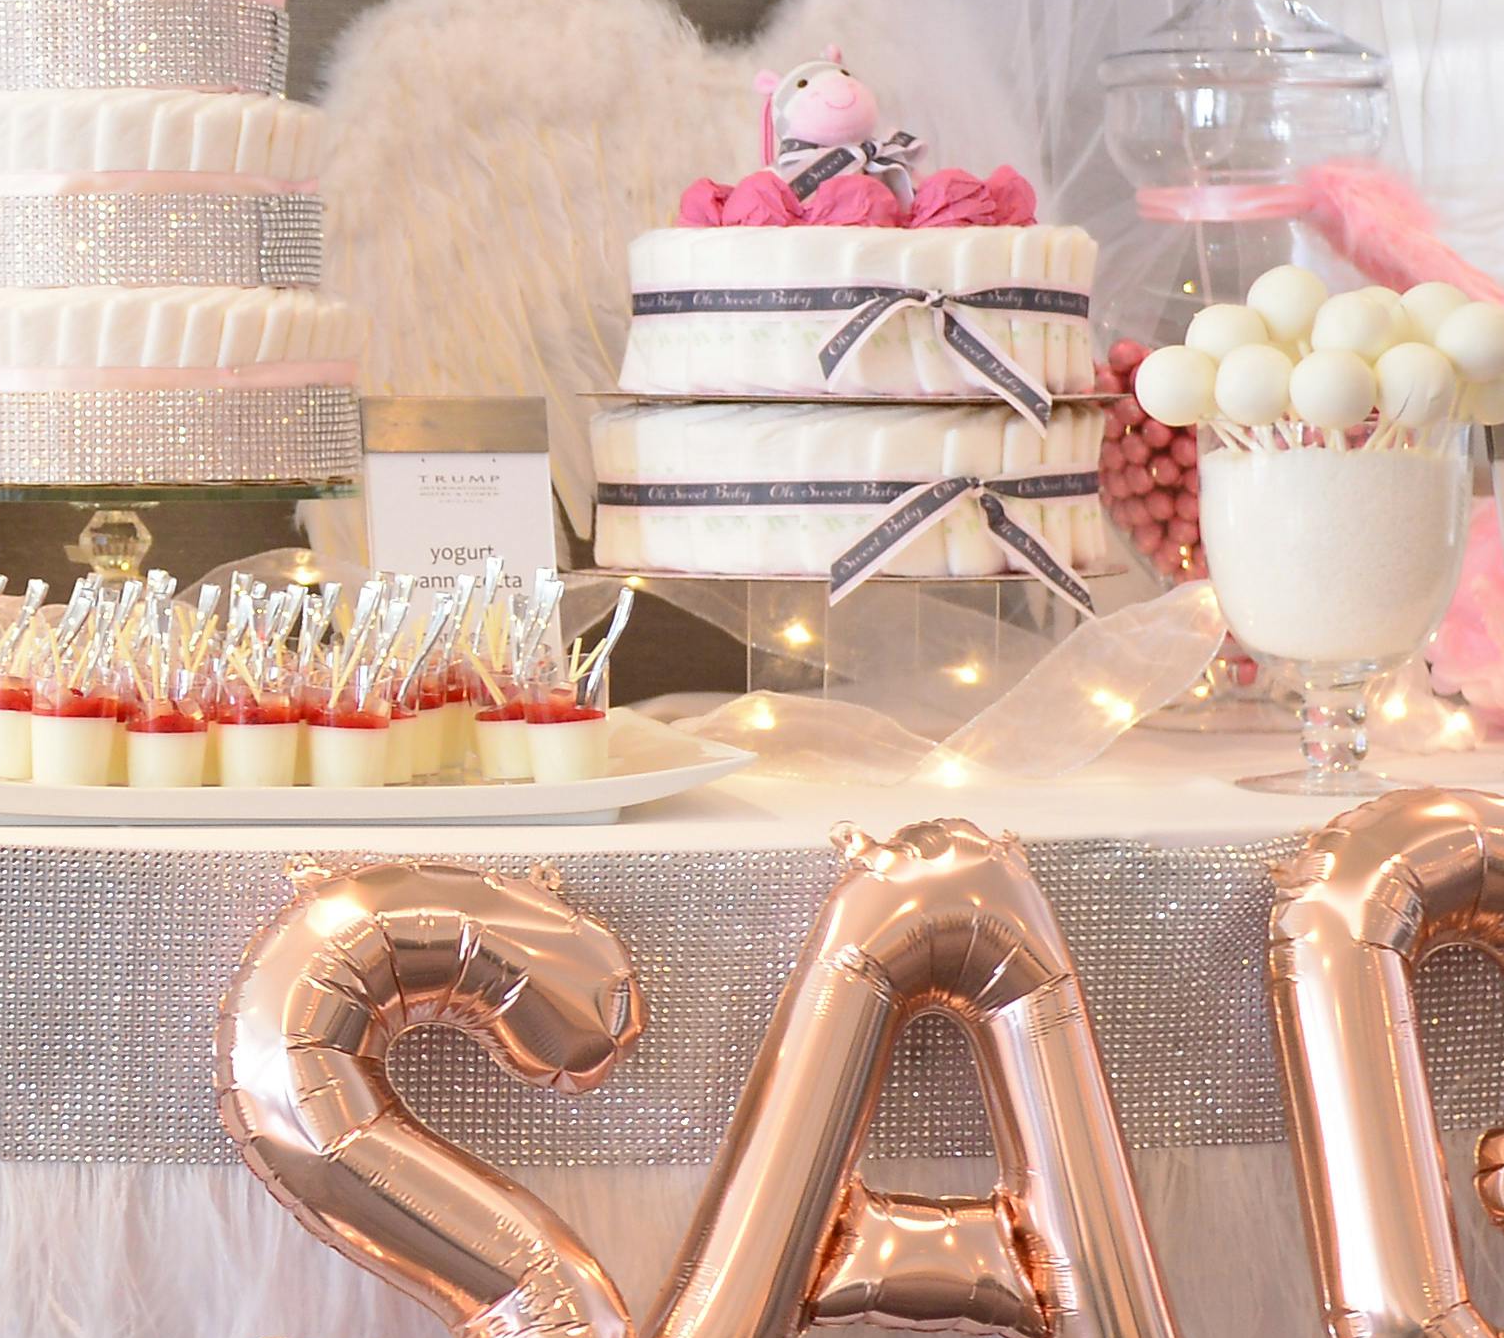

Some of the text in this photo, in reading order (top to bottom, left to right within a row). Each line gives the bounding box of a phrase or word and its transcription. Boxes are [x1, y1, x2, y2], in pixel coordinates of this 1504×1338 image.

[693, 290, 712, 306] Oh
[719, 291, 761, 305] Sweet
[769, 290, 811, 309] Baby
[832, 289, 858, 303] Oh
[950, 324, 985, 360] Sweet
[418, 475, 500, 483] TRUMP
[648, 486, 666, 499] Oh
[715, 484, 751, 503] Baby
[769, 483, 793, 498] Oh
[801, 483, 852, 497] Sweet
[839, 481, 957, 575] Sweet Baby Oh
[430, 545, 495, 565] yogurt
